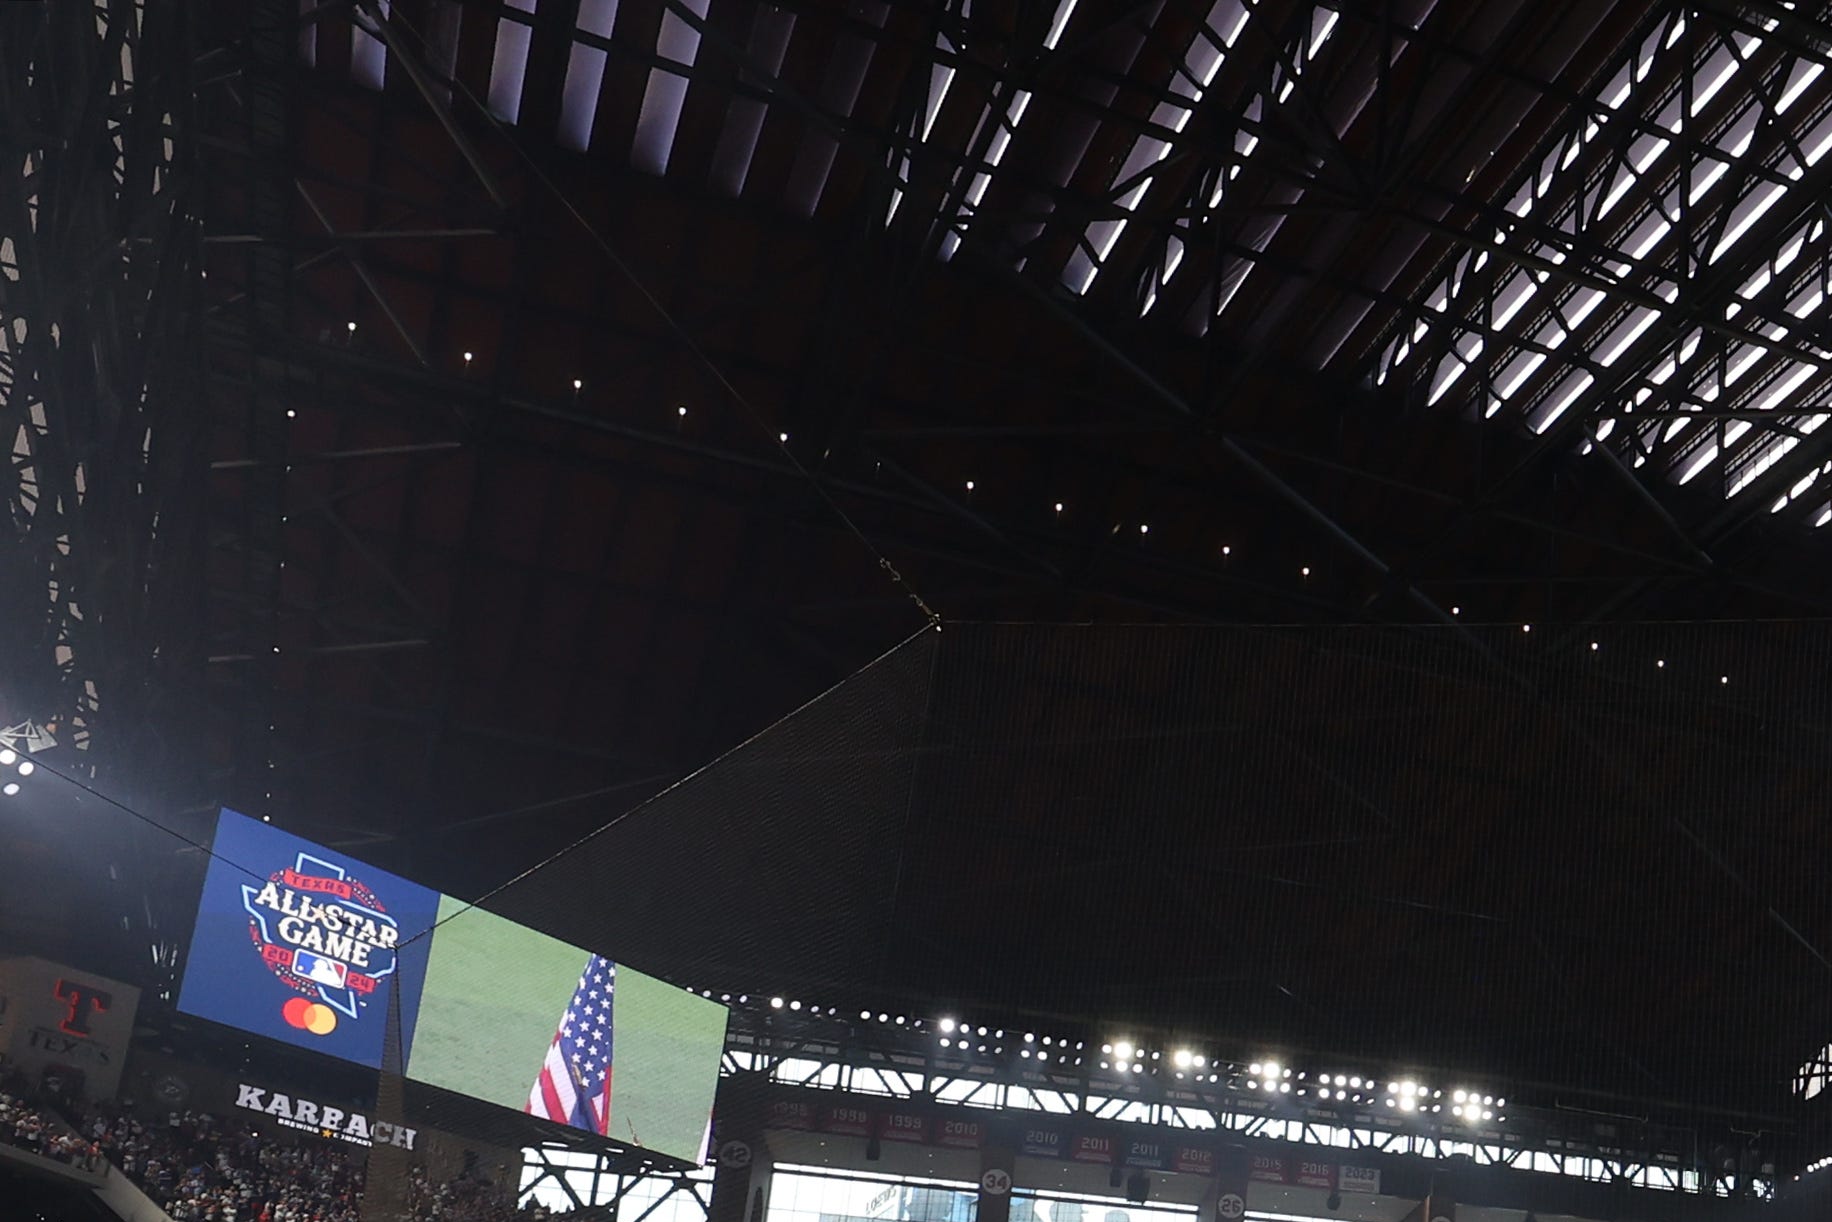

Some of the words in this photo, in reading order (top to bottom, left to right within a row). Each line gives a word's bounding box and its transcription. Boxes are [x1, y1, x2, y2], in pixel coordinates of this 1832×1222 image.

[292, 874, 346, 895] TEXAS
[254, 882, 316, 923] ALL
[322, 904, 398, 949] STAR
[278, 916, 372, 967] GAME
[235, 1084, 417, 1150] KARBACH
[945, 1121, 979, 1136] 2010
[1026, 1129, 1059, 1145] 2010
[1081, 1136, 1109, 1151] 2011
[1131, 1143, 1160, 1156] 2011
[985, 1175, 1007, 1190] 34
[1222, 1198, 1241, 1212] 26
